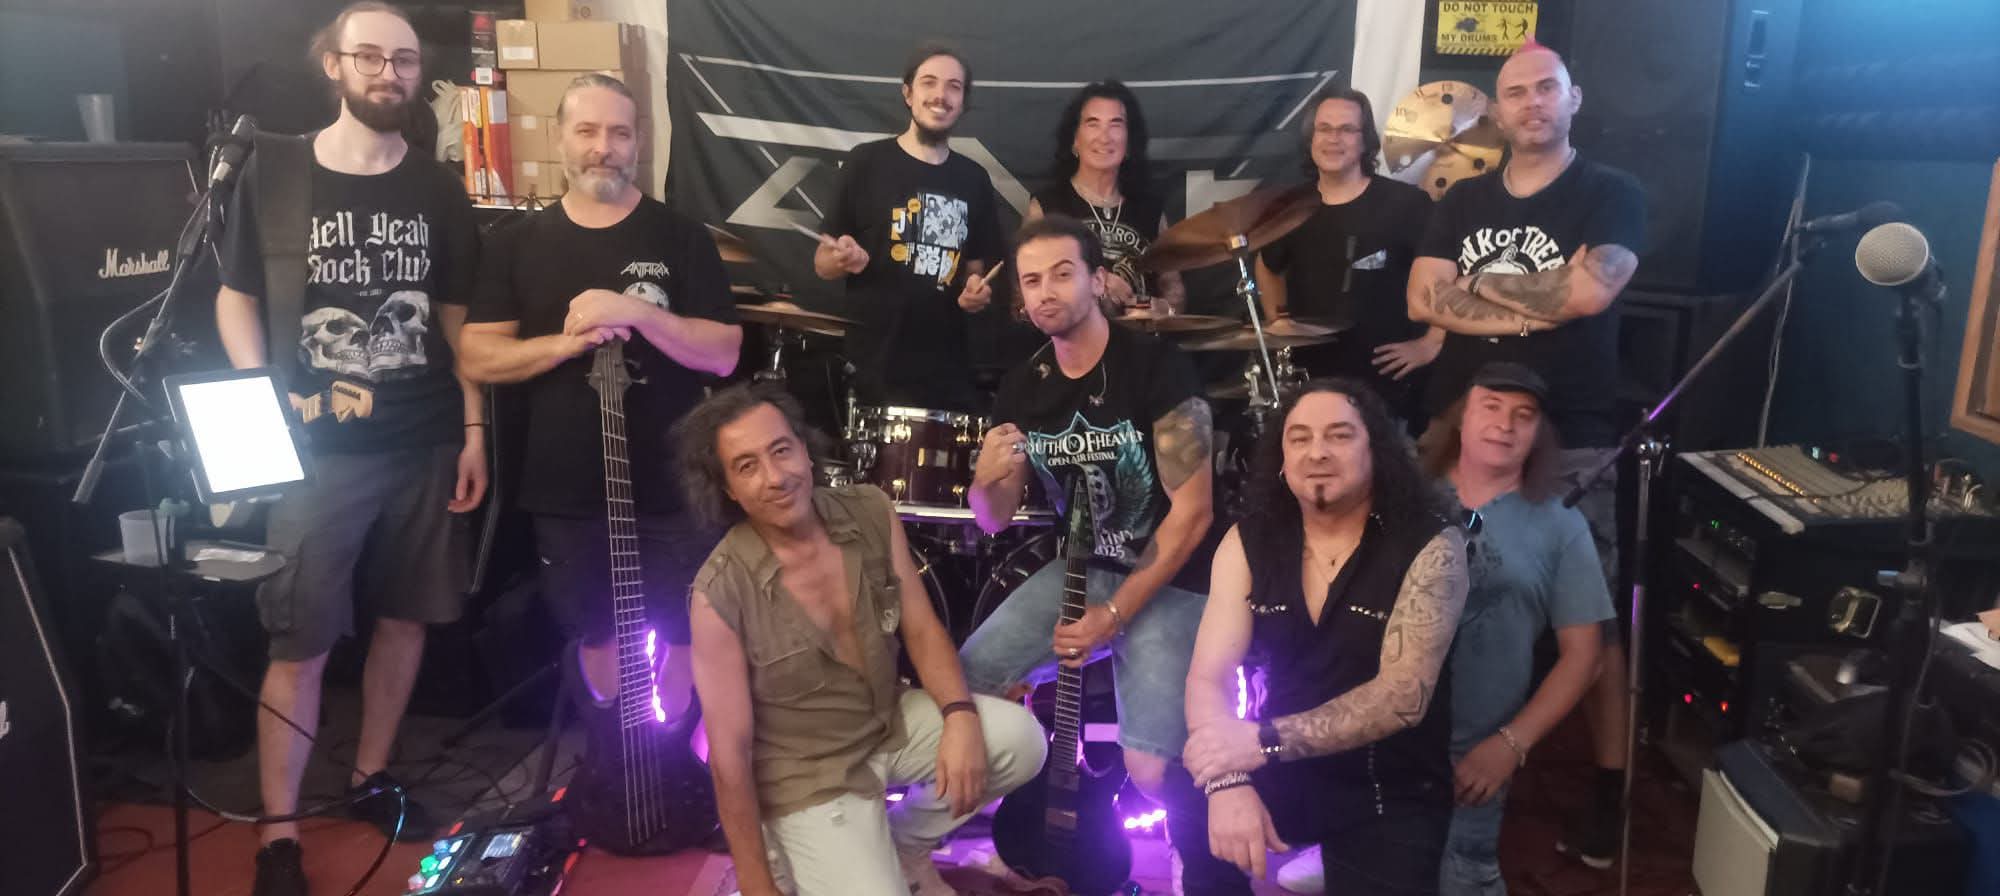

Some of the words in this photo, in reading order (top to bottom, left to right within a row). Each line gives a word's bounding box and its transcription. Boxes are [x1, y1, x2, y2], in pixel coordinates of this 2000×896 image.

[1443, 3, 1460, 12] DO
[1463, 3, 1487, 13] NOT
[1492, 4, 1534, 14] TOUCH
[1441, 33, 1457, 41] MY
[1460, 33, 1498, 42] DRUMS
[364, 211, 429, 248] Yeah
[98, 248, 170, 278] Marshall
[381, 247, 431, 282] Club
[620, 261, 670, 279] ANTHRAX
[1025, 438, 1062, 456] OUTH
[1047, 456, 1071, 467] OPEN
[1087, 450, 1118, 462] FESTIVAL
